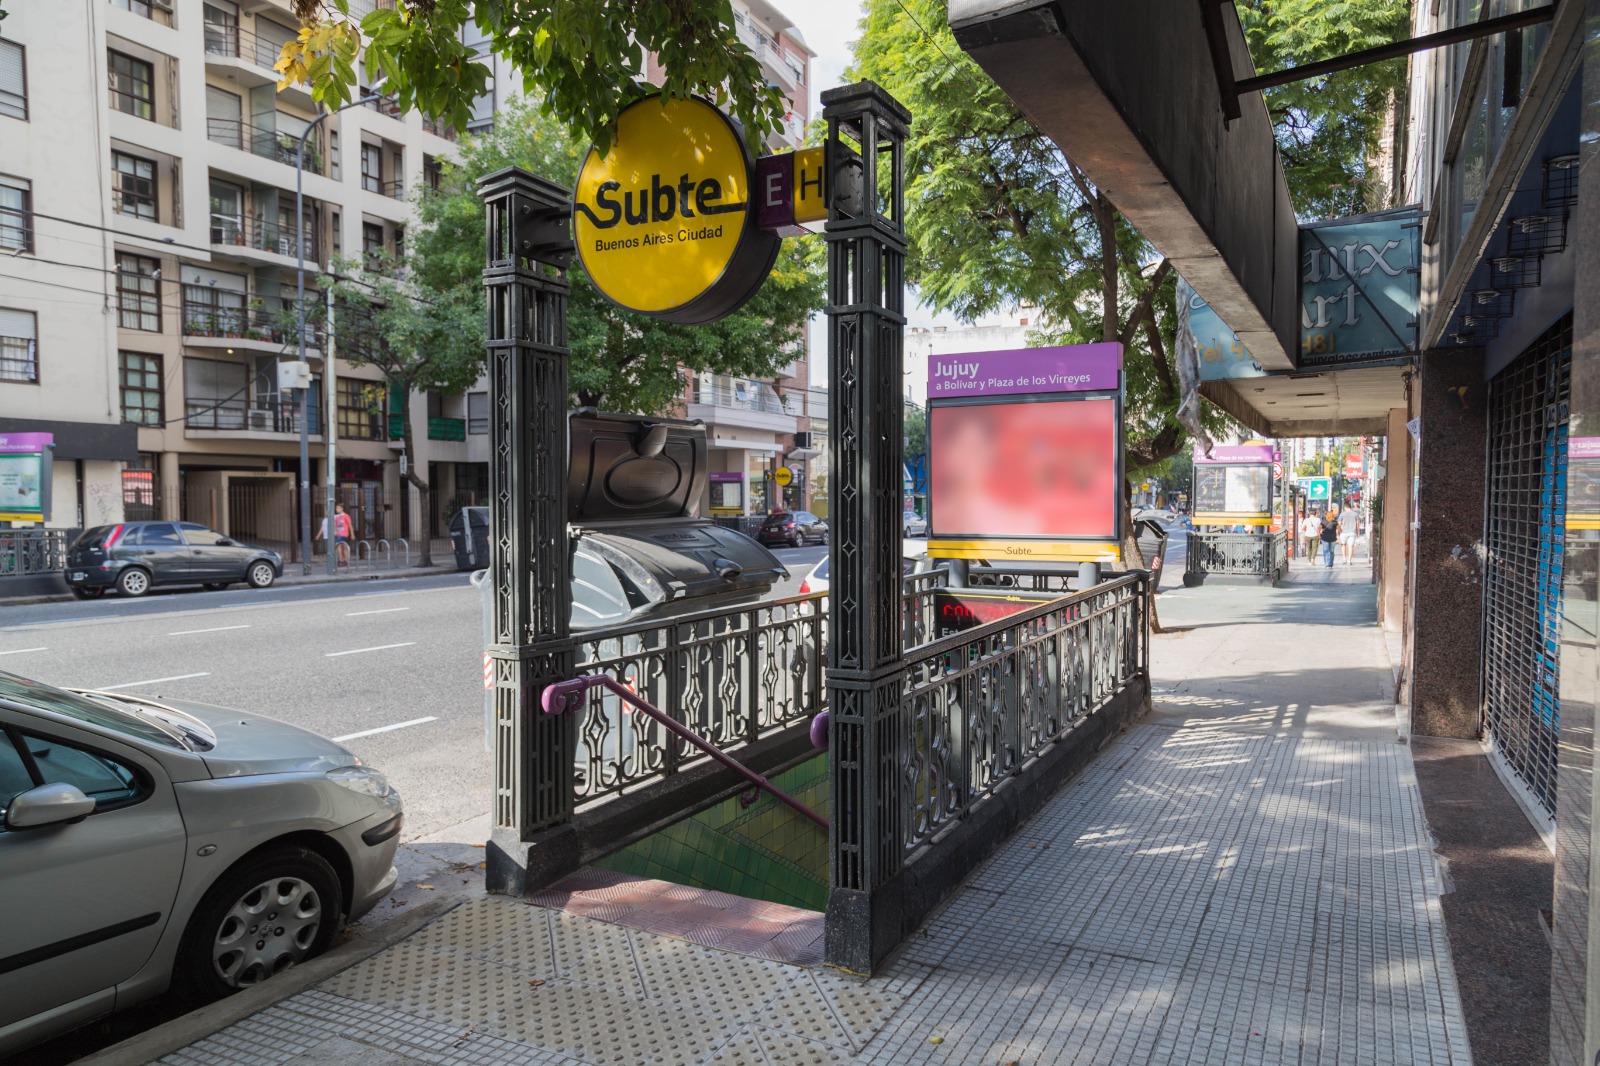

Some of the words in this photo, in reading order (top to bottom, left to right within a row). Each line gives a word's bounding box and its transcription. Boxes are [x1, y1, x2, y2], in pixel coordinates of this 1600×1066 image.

[766, 172, 783, 207] E
[800, 165, 823, 201] H
[575, 173, 746, 229] Subte
[595, 238, 640, 252] Buenos
[642, 231, 674, 247] Aires
[677, 225, 723, 242] Ciudad
[934, 360, 980, 380] Jujuy
[944, 380, 977, 390] Bolívar
[979, 381, 986, 391] y
[988, 378, 1014, 388] Plaza
[1016, 376, 1030, 386] de
[1032, 375, 1047, 385] los
[1048, 374, 1091, 385] Virreyes
[1006, 546, 1032, 556] Subte
